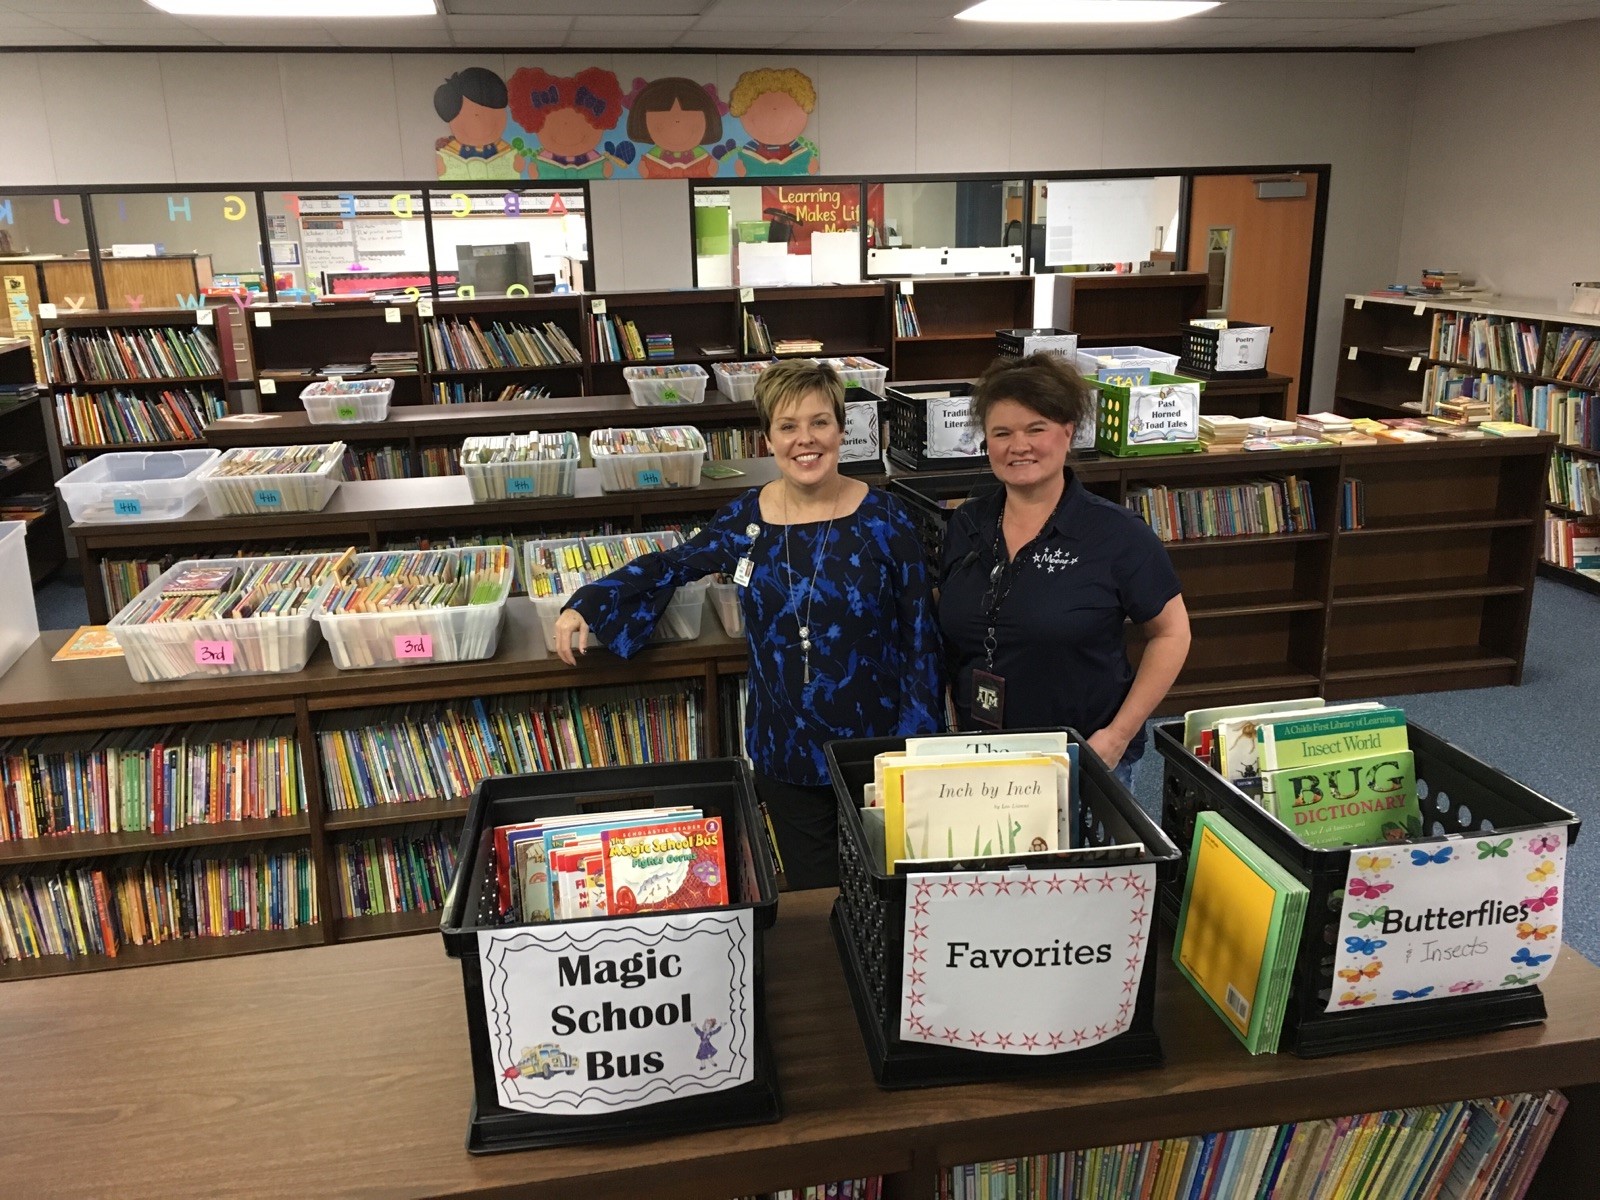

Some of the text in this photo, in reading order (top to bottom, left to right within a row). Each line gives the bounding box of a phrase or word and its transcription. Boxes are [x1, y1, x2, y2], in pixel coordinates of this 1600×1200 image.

[778, 187, 840, 208] Learning
[796, 205, 860, 222] Makes Lif
[1235, 336, 1254, 344] Poetry
[1033, 347, 1068, 357] Ghic
[1158, 400, 1176, 408] Past
[1152, 410, 1181, 419] Horned
[1145, 420, 1188, 430] Toad Tales
[514, 481, 531, 491] 4th
[643, 474, 659, 484] 4th
[258, 491, 277, 503] 4th
[119, 501, 138, 513] 4th
[200, 645, 227, 662] 3rd
[404, 638, 427, 654] 3rd
[1313, 722, 1330, 732] First
[1330, 719, 1355, 730] Library
[1355, 718, 1363, 726] of
[1364, 715, 1396, 725] Learning
[1302, 733, 1382, 757] Insect World
[938, 781, 1042, 799] Inch by Inch
[1288, 760, 1404, 808] BUG
[1294, 794, 1406, 826] DICTIONARY
[622, 824, 701, 838] SCHOLASTIC READER
[609, 833, 718, 858] Magic School Bus
[610, 837, 625, 847] The
[632, 852, 698, 869] Fights Germs
[1382, 900, 1529, 934] Butterflies
[945, 938, 1112, 968] Favorites
[1420, 936, 1489, 963] Insects
[558, 948, 682, 989] Magic
[551, 993, 692, 1036] School
[586, 1050, 665, 1082] Bus
